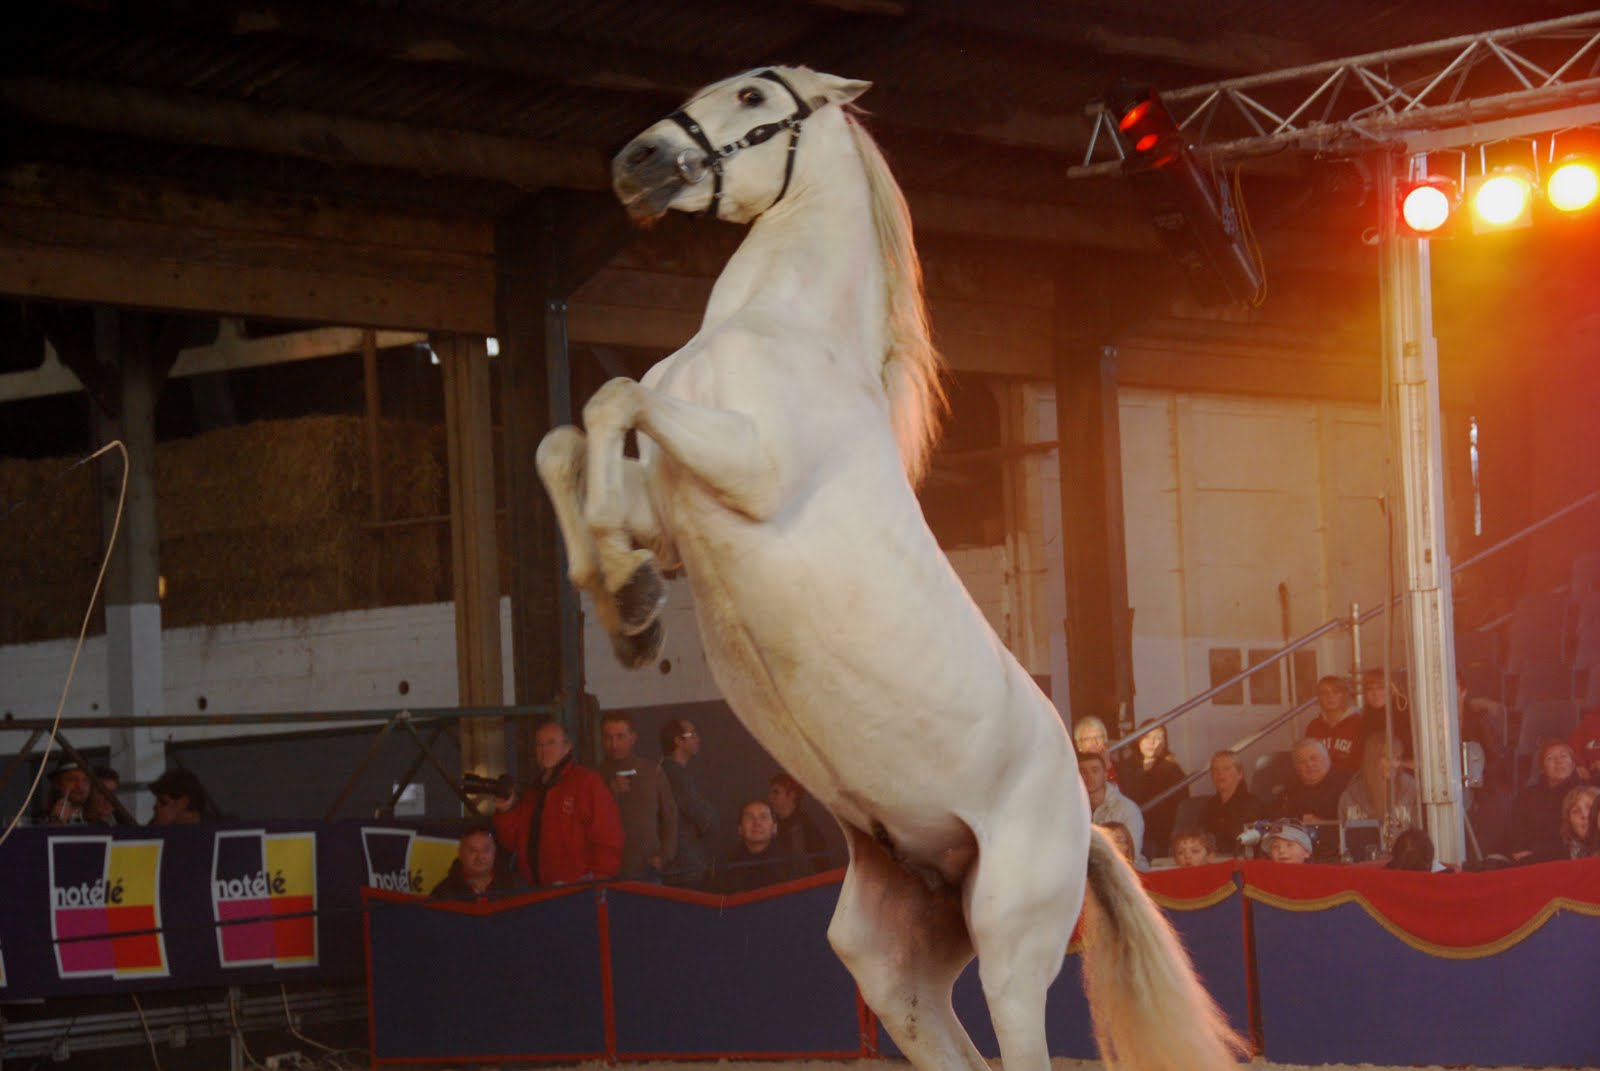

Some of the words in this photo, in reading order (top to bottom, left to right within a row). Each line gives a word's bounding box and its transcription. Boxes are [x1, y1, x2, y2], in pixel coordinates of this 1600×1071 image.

[53, 878, 125, 907] notélé
[214, 869, 287, 899] notélé
[370, 868, 424, 893] notélé
